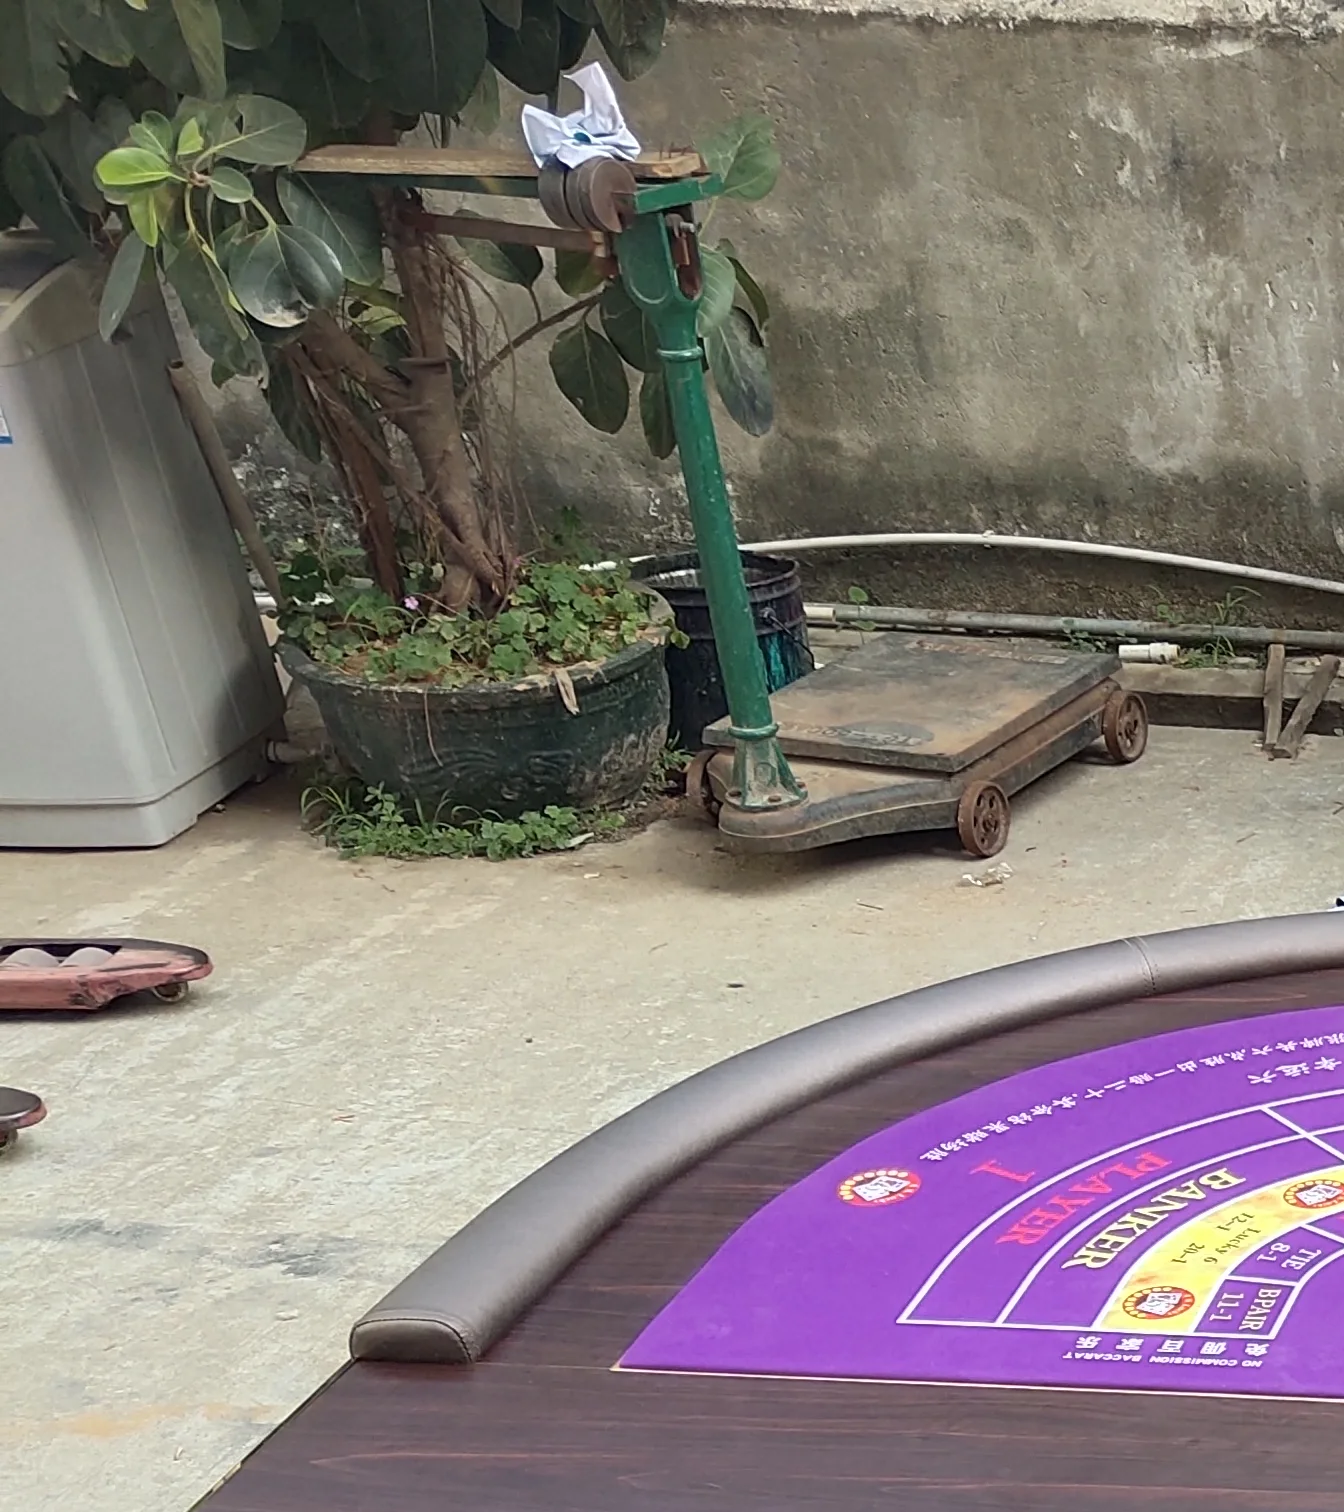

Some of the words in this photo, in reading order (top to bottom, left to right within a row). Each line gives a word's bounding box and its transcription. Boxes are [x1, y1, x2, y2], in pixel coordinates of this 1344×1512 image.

[1247, 1056, 1342, 1086] 幸运六
[969, 1160, 1035, 1183] 1
[995, 1151, 1172, 1246] PLAYER
[1061, 1167, 1246, 1269] BANKER
[1171, 1242, 1205, 1263] 20-1
[1215, 1227, 1261, 1255] Lucky
[1256, 1242, 1291, 1262] 8-1
[1281, 1248, 1322, 1271] TIE
[1209, 1292, 1244, 1321] 11-1
[1062, 1351, 1141, 1364] BACCARAT
[1149, 1355, 1238, 1367] COMMISSION
[1241, 1359, 1263, 1368] NO
